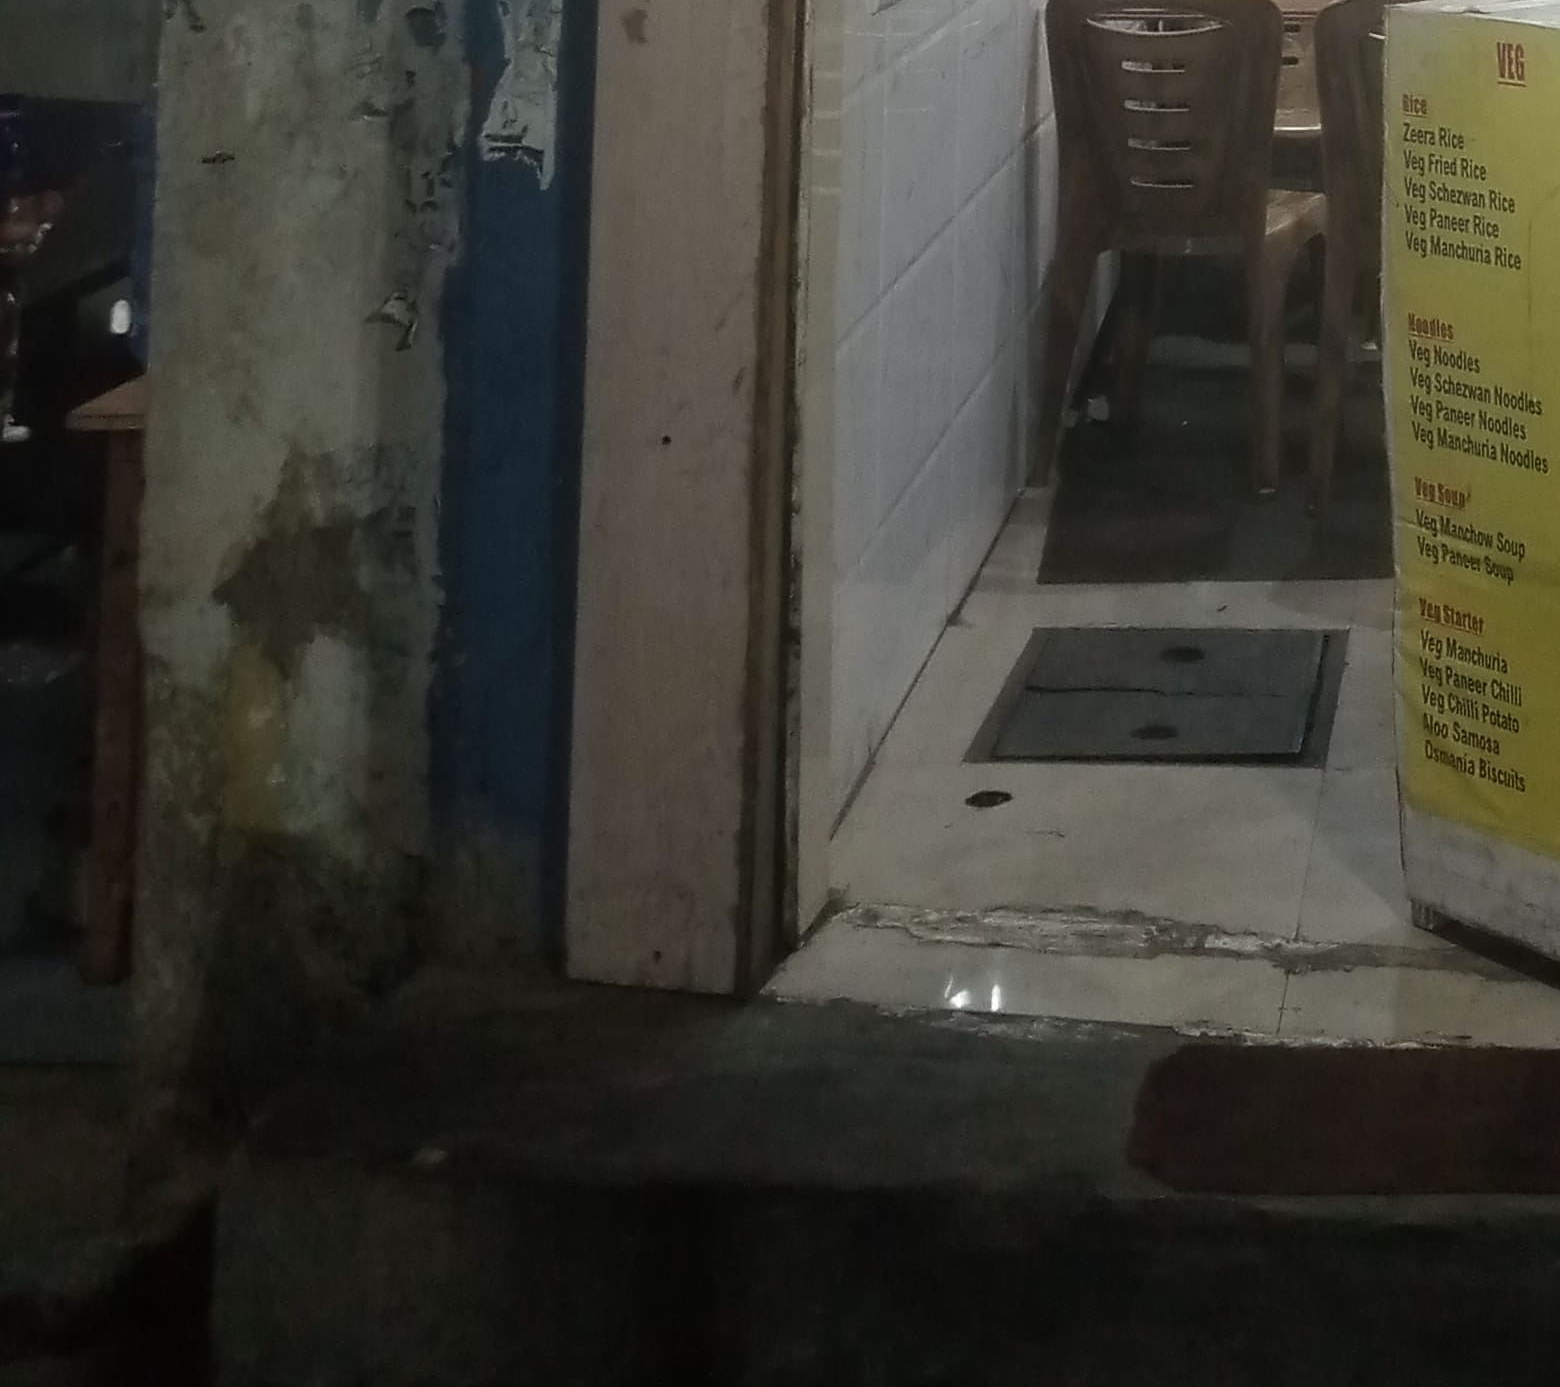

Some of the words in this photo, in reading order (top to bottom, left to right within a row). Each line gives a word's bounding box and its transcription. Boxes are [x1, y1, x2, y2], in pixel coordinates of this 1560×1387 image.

[1497, 42, 1525, 81] VEG
[1439, 128, 1464, 149] Rice
[1404, 151, 1425, 177] Veg
[1428, 155, 1457, 178] Fried
[1461, 159, 1487, 181] Rice
[1404, 177, 1426, 204] Veg
[1429, 180, 1486, 209] Schezwan
[1489, 190, 1516, 213] Rice
[1405, 204, 1426, 230] Veg
[1429, 208, 1470, 235] Paneer
[1473, 216, 1500, 239] Rice
[1406, 231, 1427, 258] Veg
[1430, 235, 1492, 266] Manchuria
[1494, 246, 1522, 271] Rice
[1453, 723, 1500, 755] Samosa
[1479, 758, 1525, 793] Biscuits
